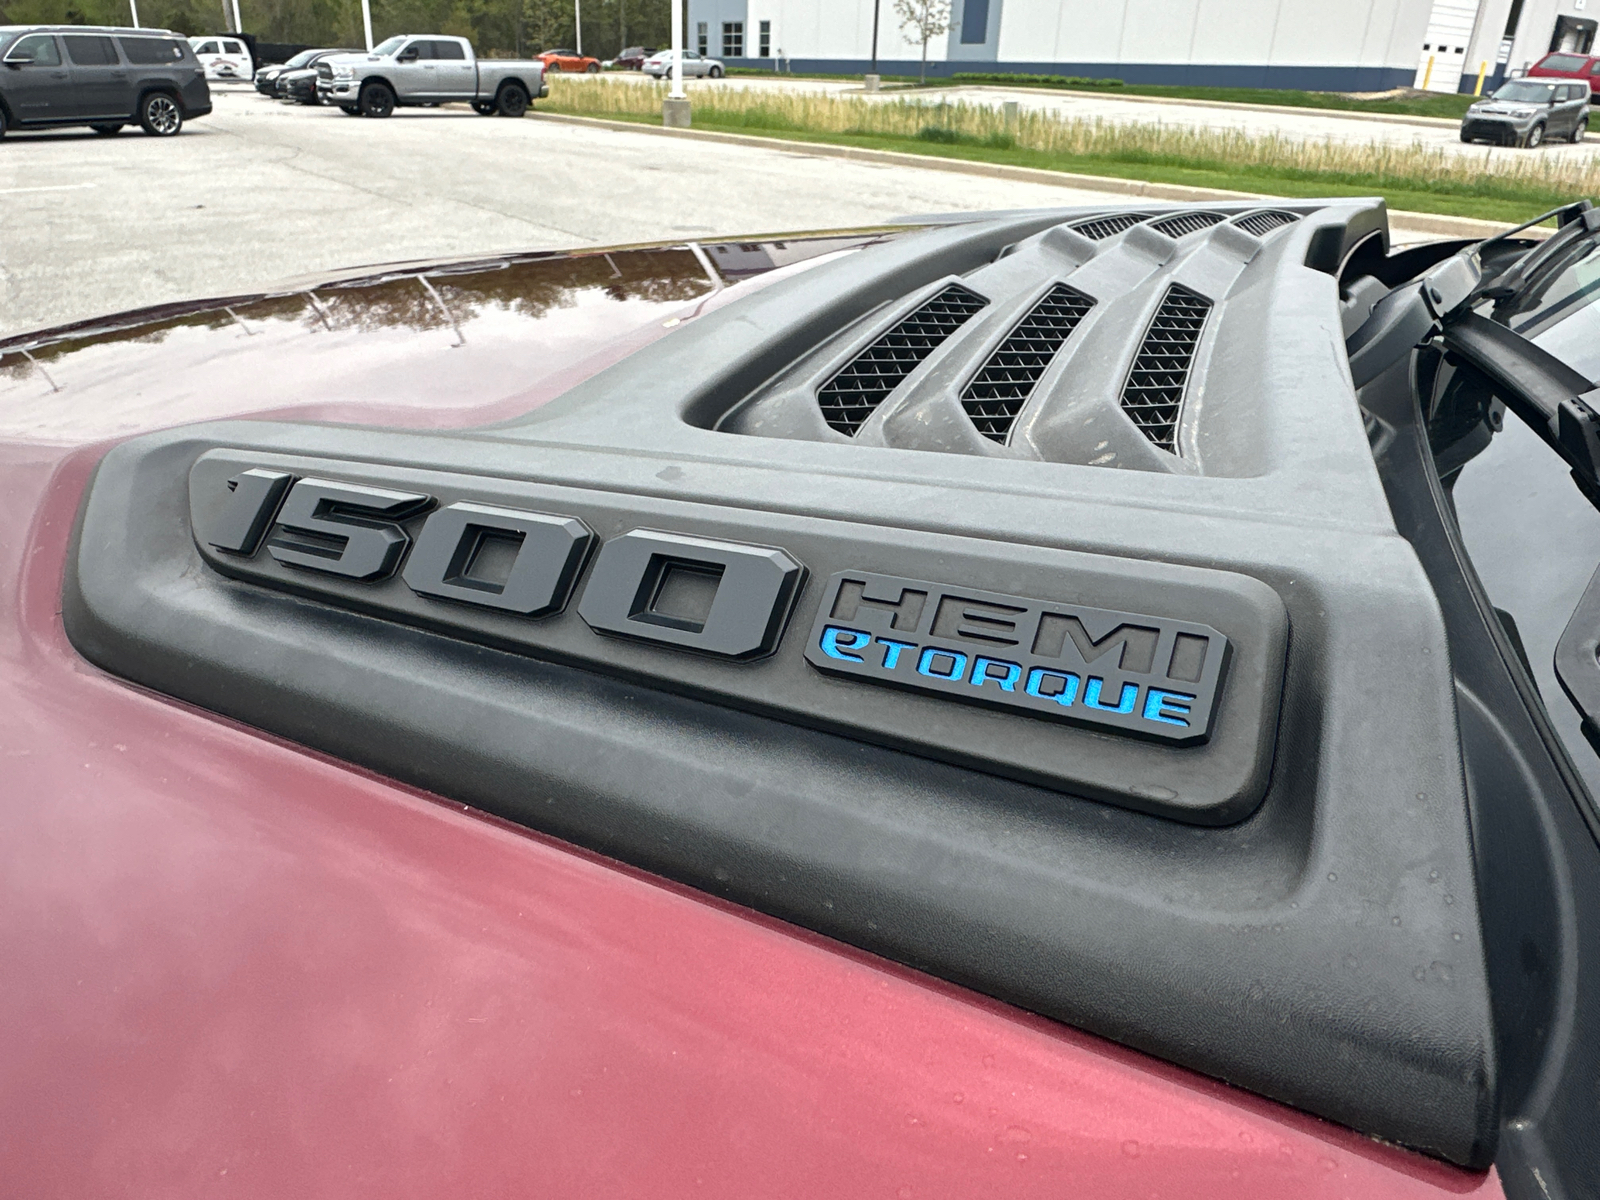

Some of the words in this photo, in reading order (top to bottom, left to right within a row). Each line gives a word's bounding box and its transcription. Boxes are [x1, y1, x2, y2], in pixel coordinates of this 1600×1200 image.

[207, 467, 809, 662] 1500
[819, 624, 1198, 728] eTORQUE
[829, 578, 1210, 684] HEMI
